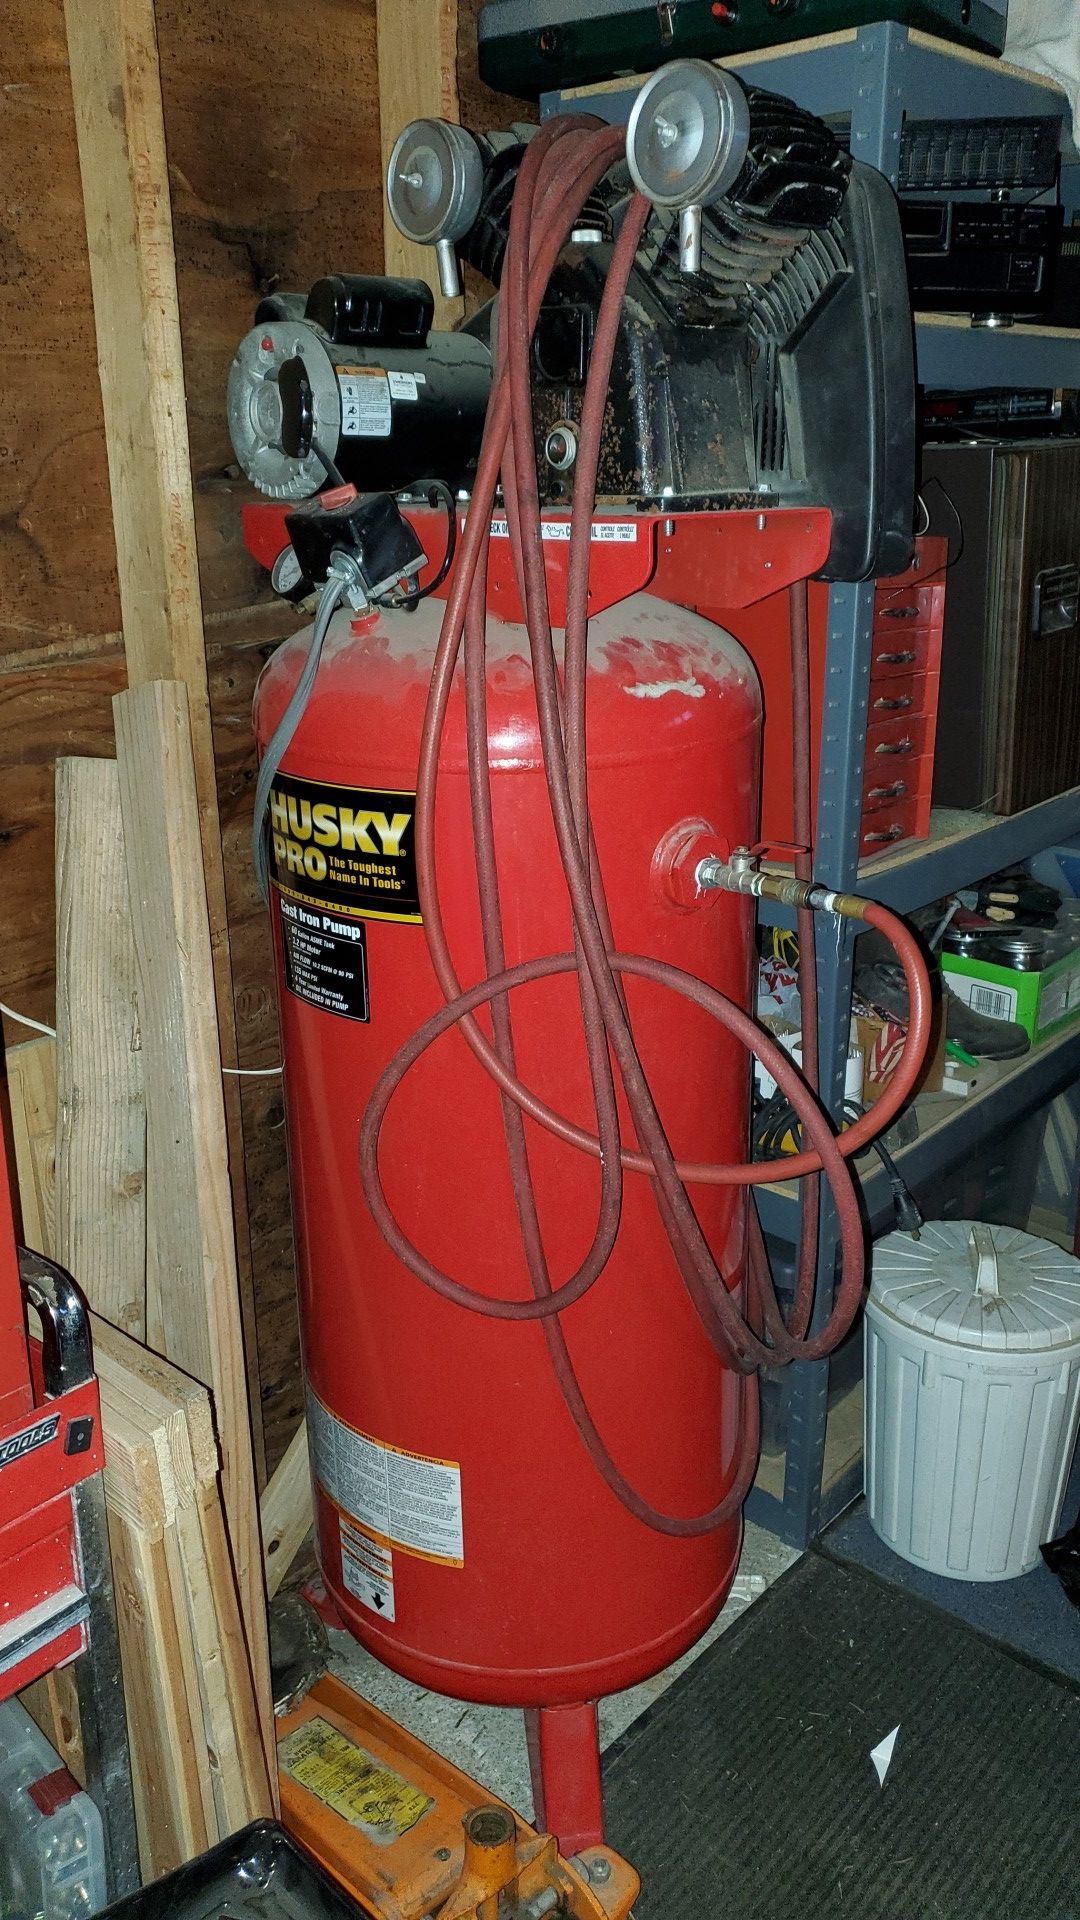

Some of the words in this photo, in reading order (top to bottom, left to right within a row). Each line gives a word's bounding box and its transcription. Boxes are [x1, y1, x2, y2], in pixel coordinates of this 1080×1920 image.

[270, 788, 412, 857] HUSKY
[272, 832, 328, 881] PRO
[328, 856, 346, 869] The
[347, 860, 397, 876] Toughest
[329, 869, 357, 884] Name
[359, 875, 370, 887] In
[372, 877, 402, 890] Tools
[280, 898, 298, 920] Cast
[299, 907, 320, 928] Iron
[322, 916, 361, 941] Pump
[291, 925, 298, 935] 60
[300, 954, 311, 965] FLOW
[301, 969, 311, 979] MAX
[310, 974, 318, 982] PSI
[302, 988, 325, 1003] INCLUDED
[324, 998, 331, 1006] IN
[331, 1000, 349, 1011] PUMP
[320, 987, 344, 1002] Warranty
[401, 1450, 444, 1466] ADVERTENCIA
